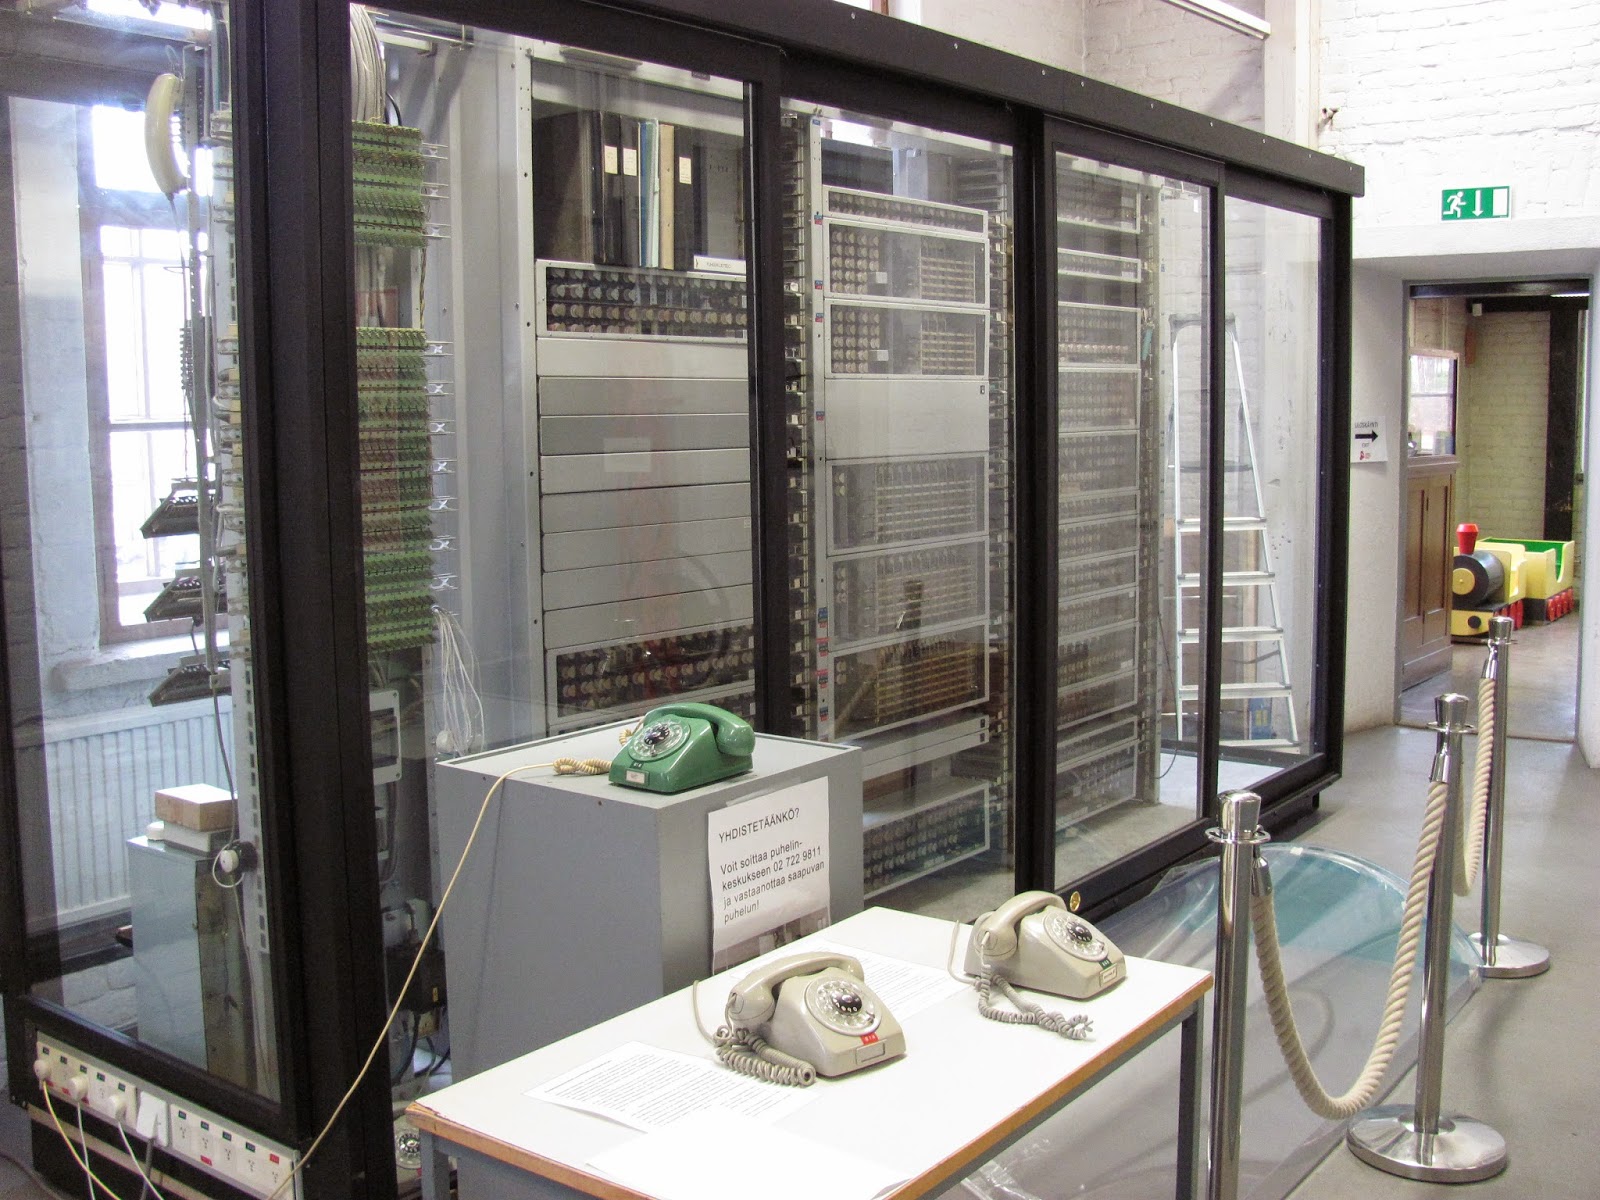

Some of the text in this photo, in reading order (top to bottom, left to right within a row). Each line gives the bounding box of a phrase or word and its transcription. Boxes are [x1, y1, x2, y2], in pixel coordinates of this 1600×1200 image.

[718, 807, 800, 843] YHDISTETÄÄNKÖ?
[720, 839, 803, 875] Voit soittaa puhelin-
[722, 845, 821, 891] keskukseen 02 722 9811
[723, 861, 825, 910] ja vastaanottaa saapuvan
[724, 900, 760, 925] puhelun!
